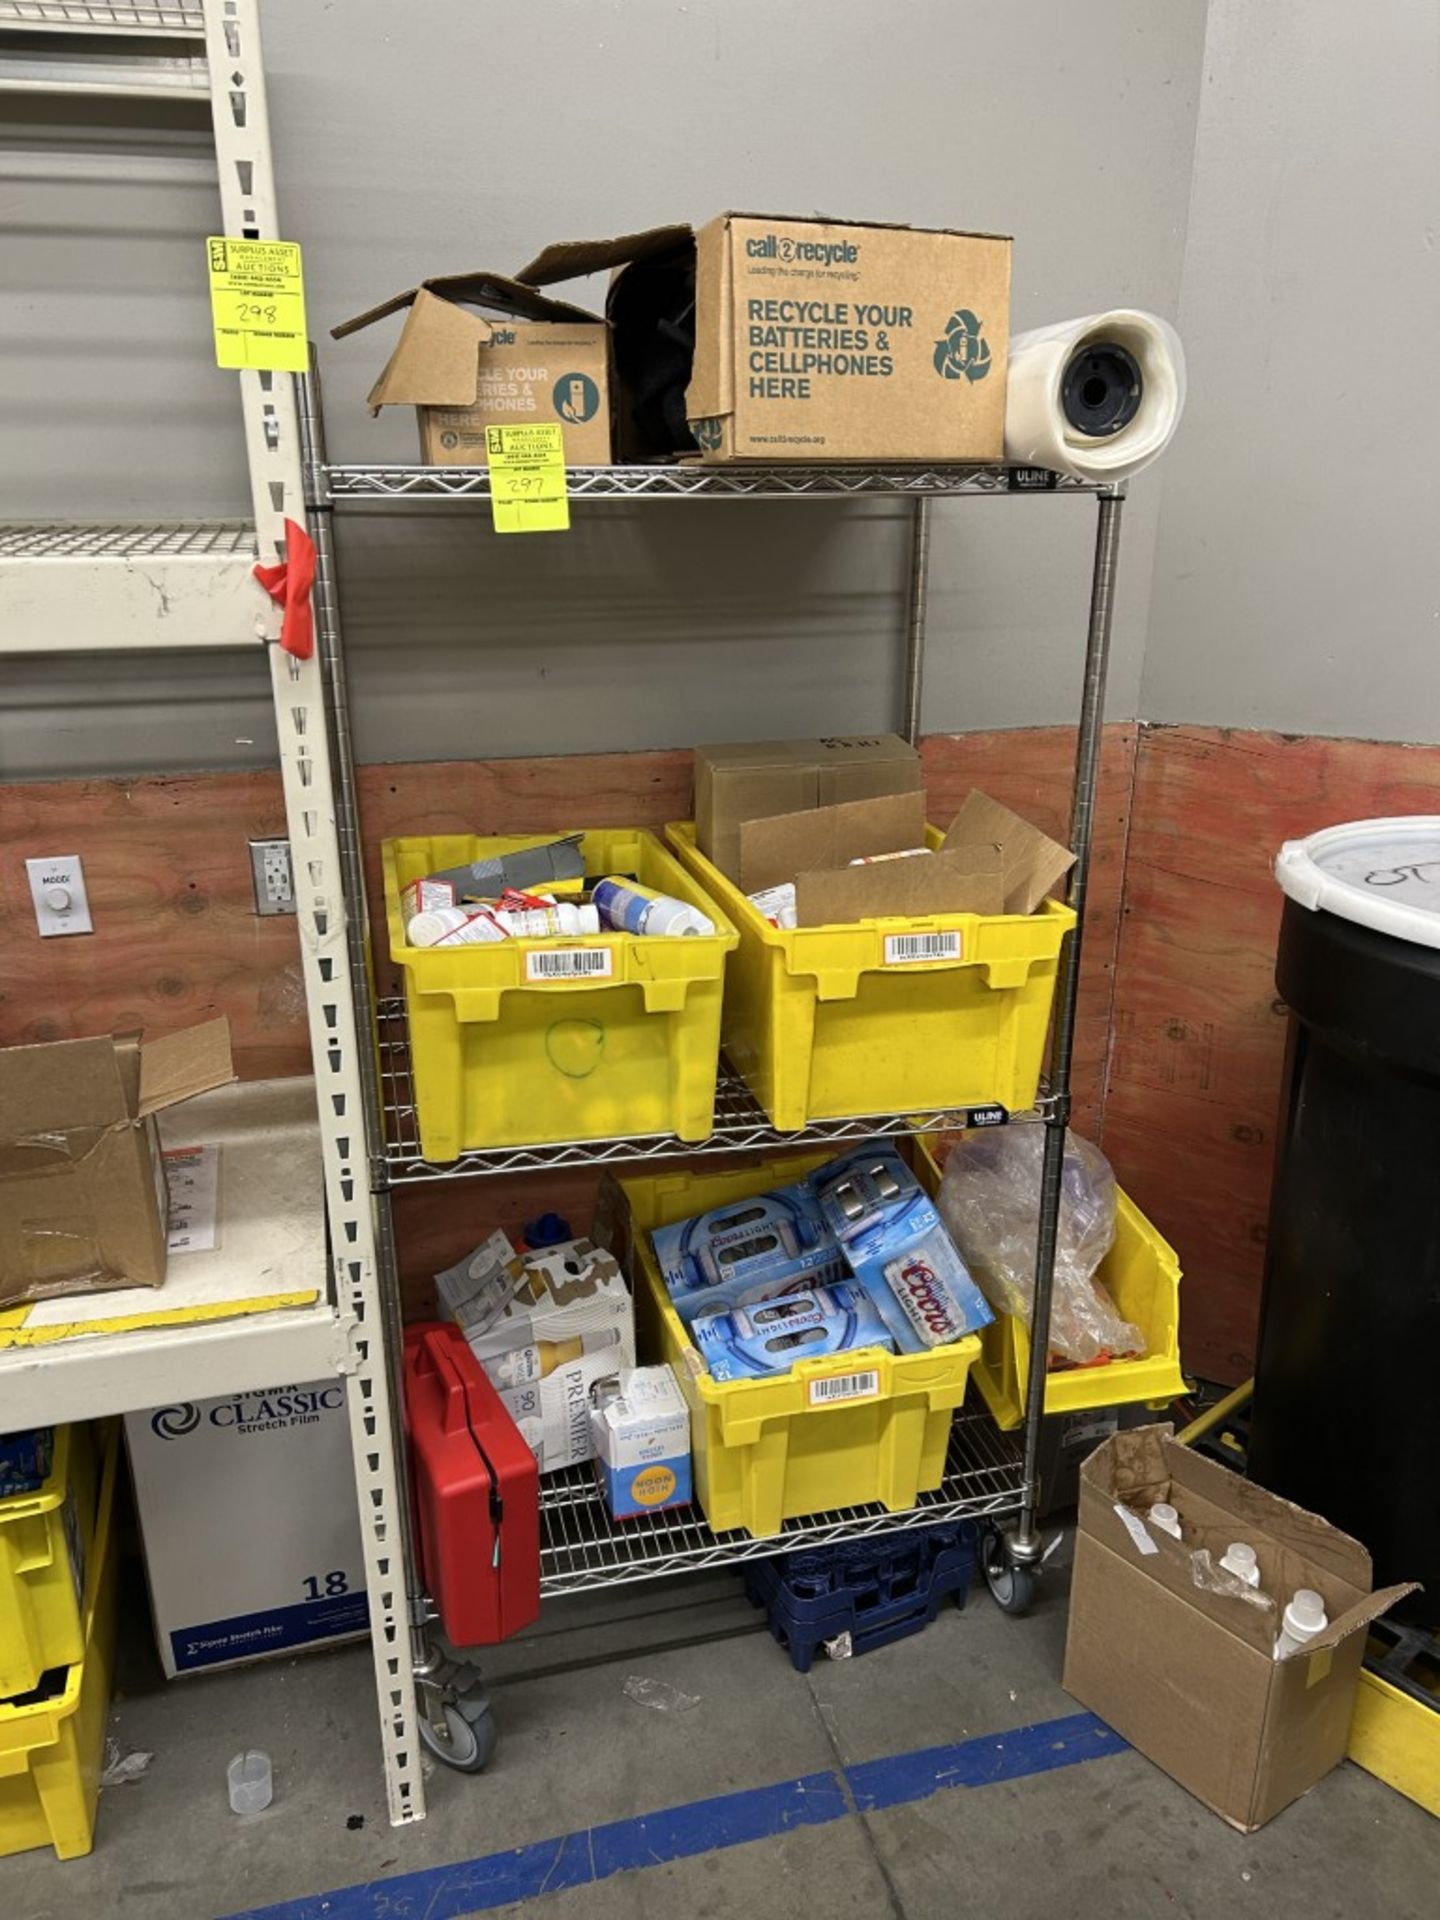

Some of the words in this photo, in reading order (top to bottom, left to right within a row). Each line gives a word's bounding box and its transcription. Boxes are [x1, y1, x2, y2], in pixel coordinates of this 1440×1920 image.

[230, 245, 267, 255] SURPLUS
[269, 249, 294, 257] ASSET
[236, 262, 290, 274] AUCTIONS
[235, 303, 277, 324] 298
[748, 299, 848, 324] RECYCLE
[854, 304, 913, 327] YOUR
[749, 326, 869, 350] BATTERIES
[875, 330, 890, 350] &
[506, 368, 549, 380] YOUR
[749, 351, 893, 376] CELLPHONES
[523, 384, 533, 395] &
[749, 377, 811, 399] HERE
[506, 477, 544, 494] 297
[1017, 470, 1050, 482] ULINE
[974, 1110, 1003, 1122] ULINE
[897, 1286, 922, 1324] LIGHT
[901, 1257, 954, 1336] Coors
[209, 1387, 343, 1428] CLASSIC
[566, 1369, 589, 1460] PREMIER
[237, 1417, 288, 1435] Stretch
[291, 1413, 321, 1426] Film
[301, 1571, 349, 1601] 18
